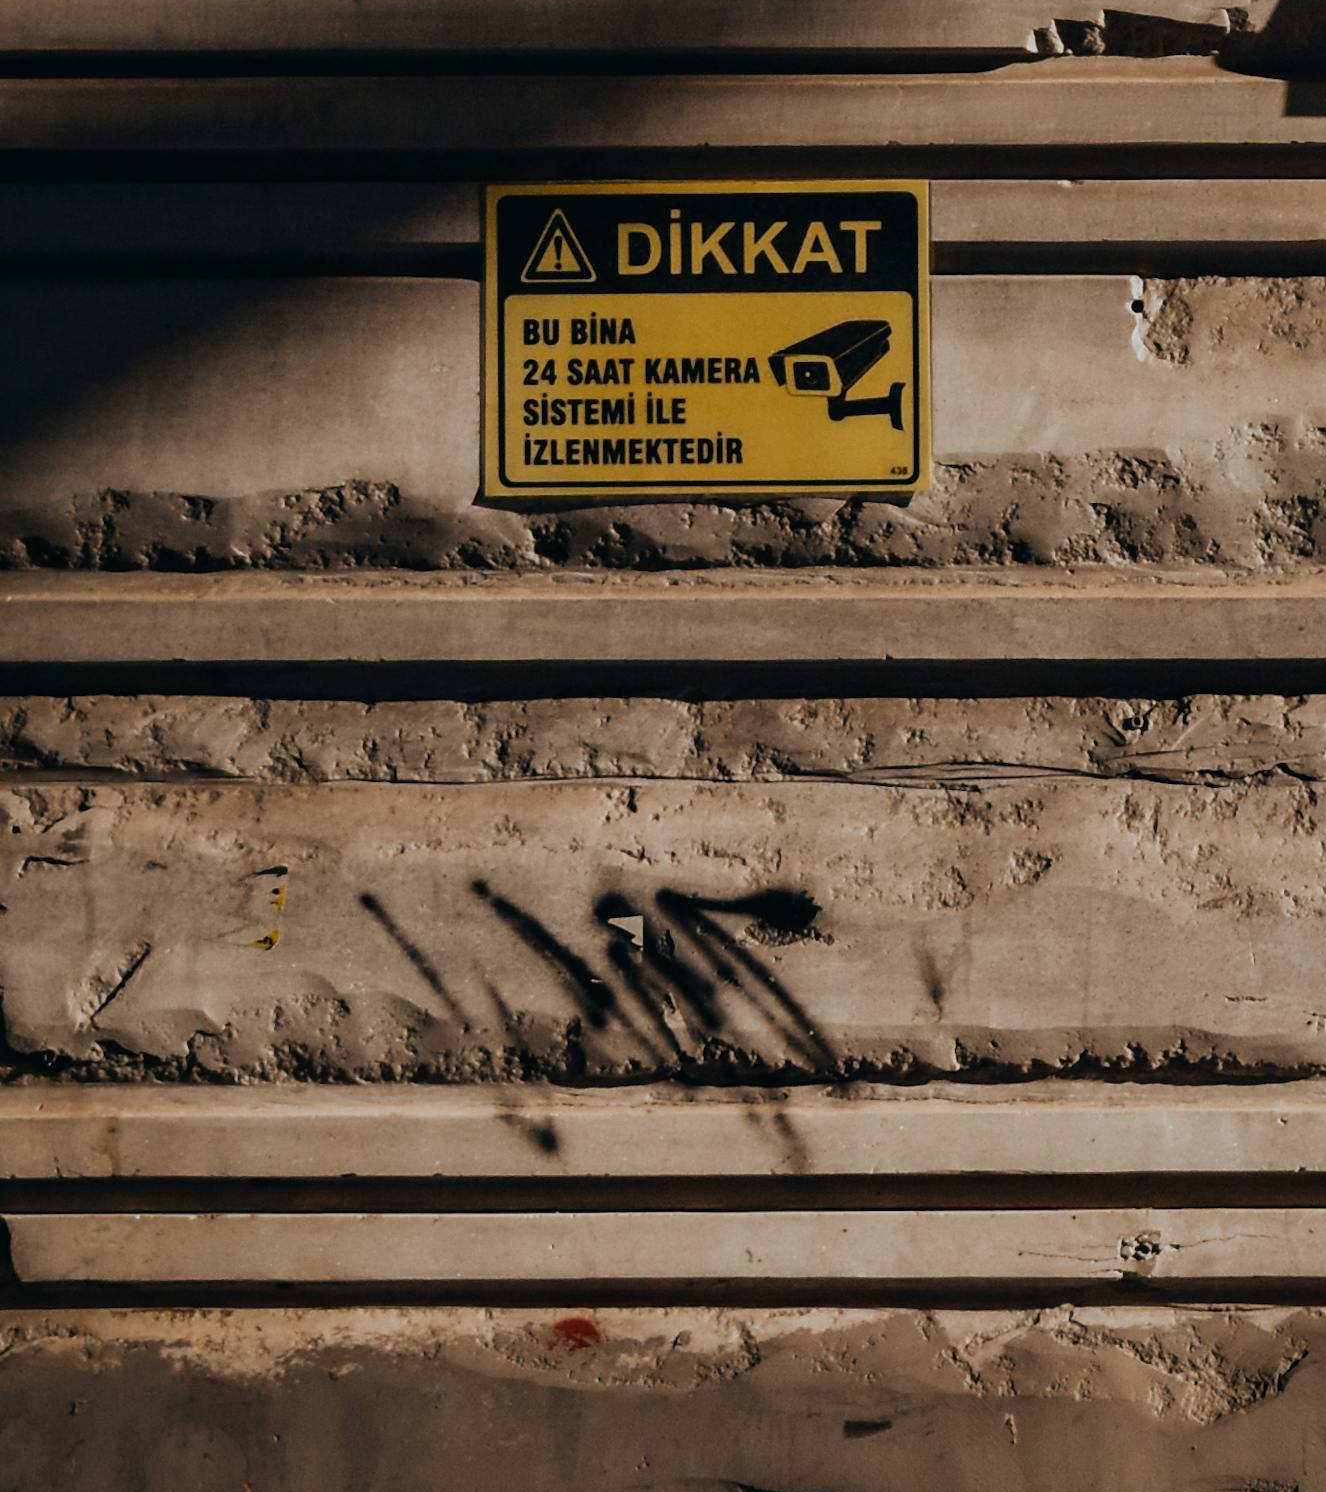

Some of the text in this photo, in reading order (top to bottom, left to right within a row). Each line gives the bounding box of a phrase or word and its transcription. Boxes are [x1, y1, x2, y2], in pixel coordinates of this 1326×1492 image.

[617, 208, 882, 276] DİKKAT
[523, 312, 636, 345] BU BİNA
[523, 357, 760, 385] 24 SAAT KAMERA
[523, 392, 686, 425] SİSTEMİ İLE
[524, 432, 743, 465] İZLENMEKTEDİR
